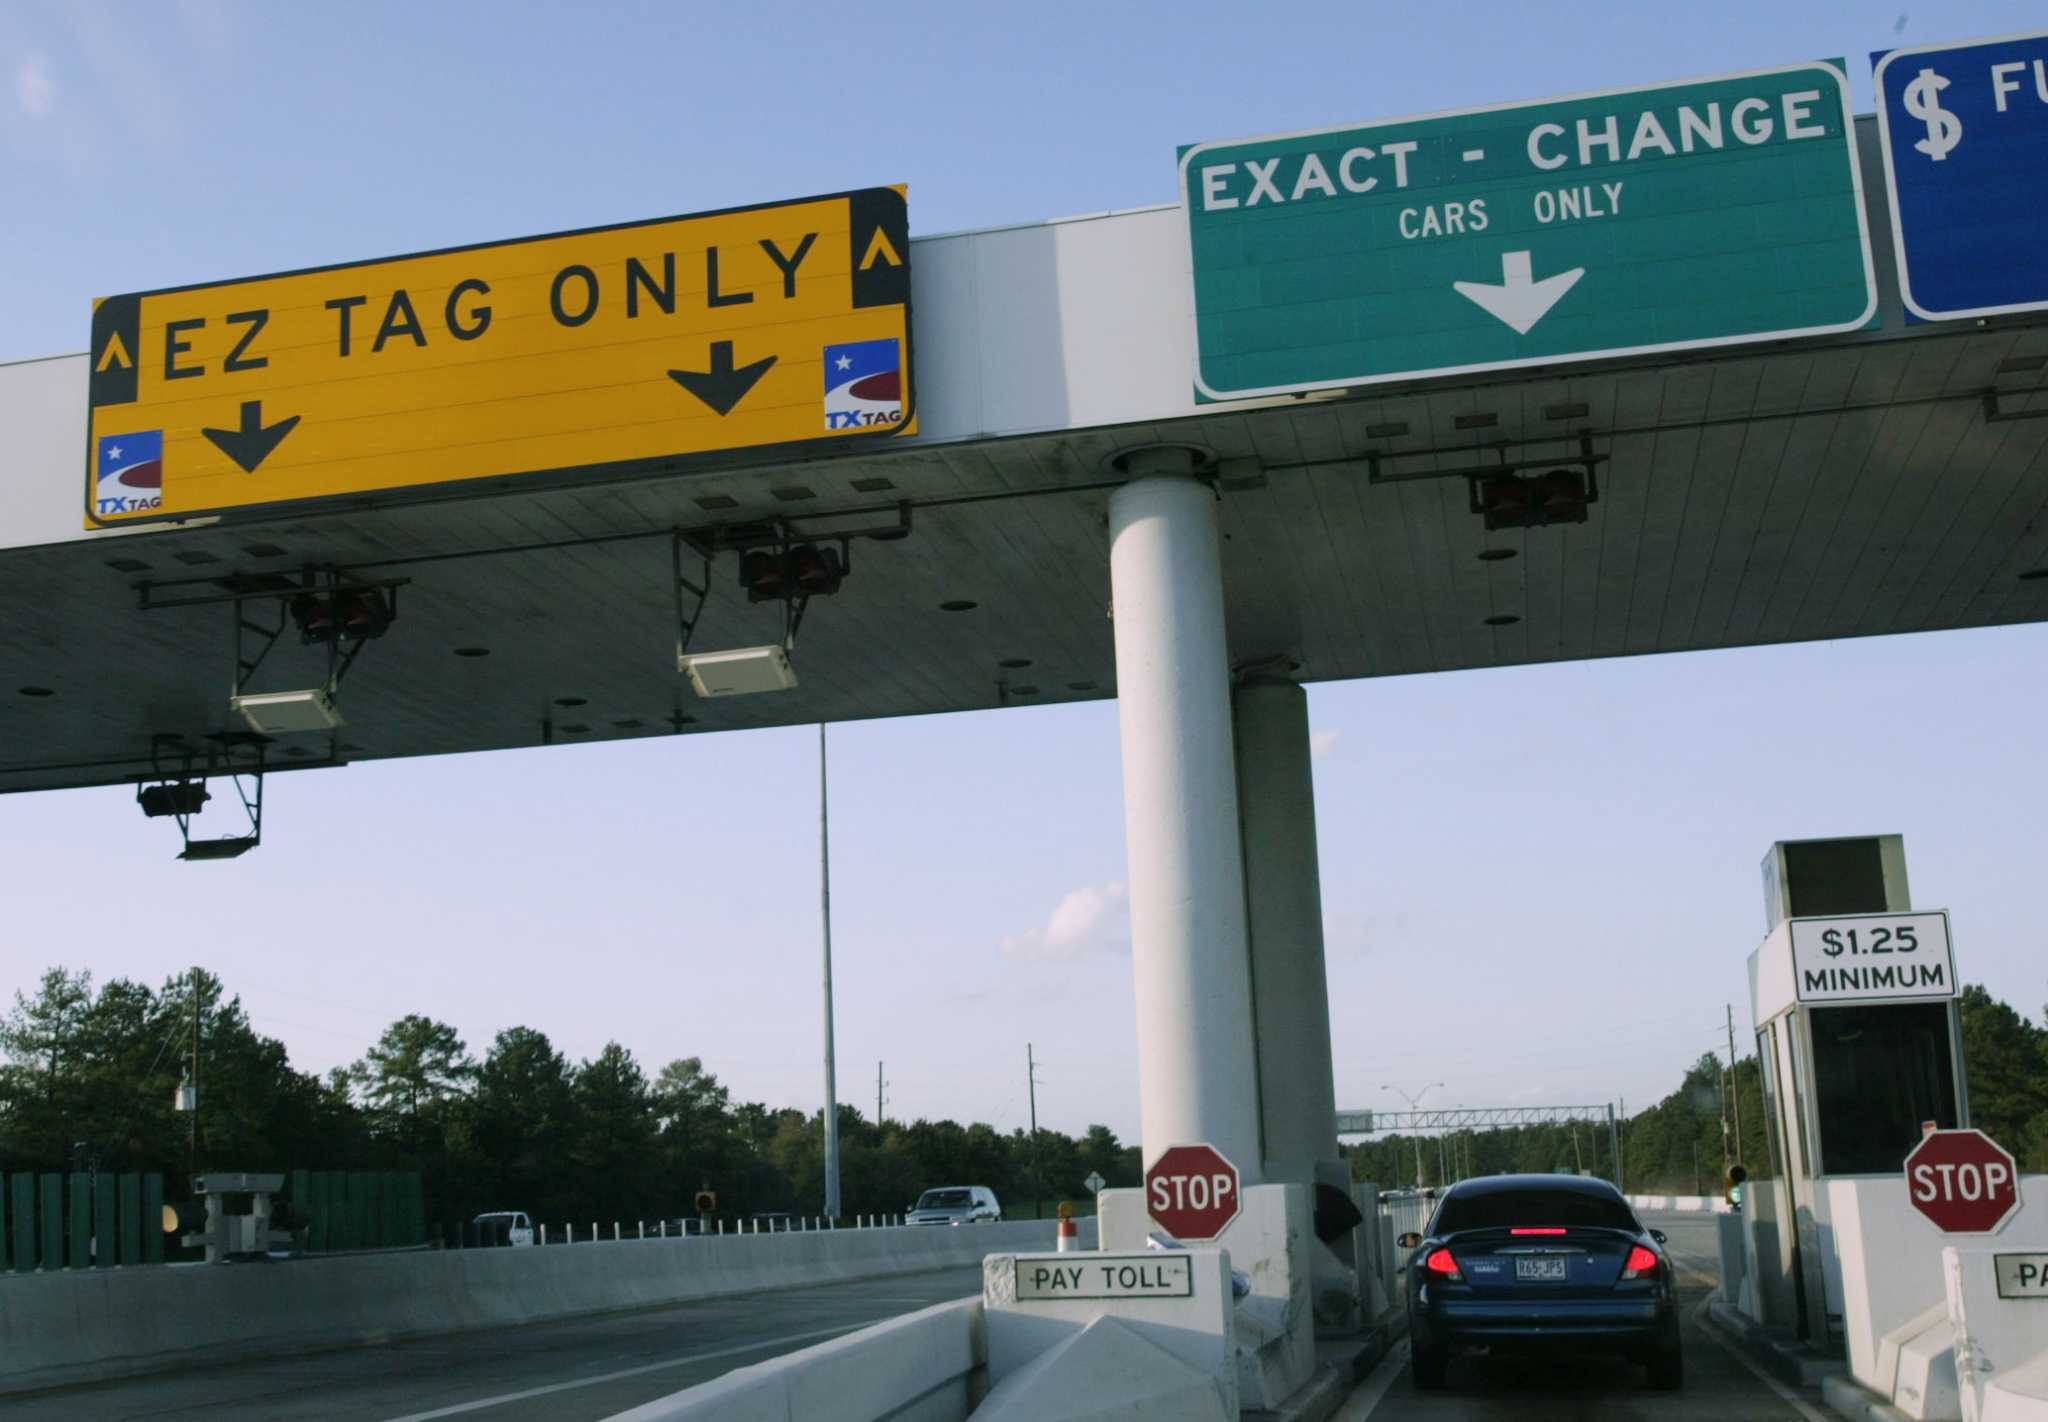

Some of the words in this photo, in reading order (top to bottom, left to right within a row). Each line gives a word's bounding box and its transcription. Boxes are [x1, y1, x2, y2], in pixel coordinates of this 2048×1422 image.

[1202, 141, 1417, 211] EXACT
[1527, 90, 1825, 170] CHANGE
[1399, 199, 1489, 239] CARS
[1534, 182, 1623, 223] ONLY
[164, 308, 269, 380] EZ
[325, 279, 492, 357] TAG
[549, 232, 818, 328] ONLY
[1821, 926, 1918, 959] $1.25
[1804, 963, 1944, 992] MINIMUM
[1151, 1174, 1232, 1211] STOP
[1914, 1163, 2008, 1202] STOP
[1034, 1267, 1083, 1289] PAY
[1101, 1266, 1171, 1289] TOLL
